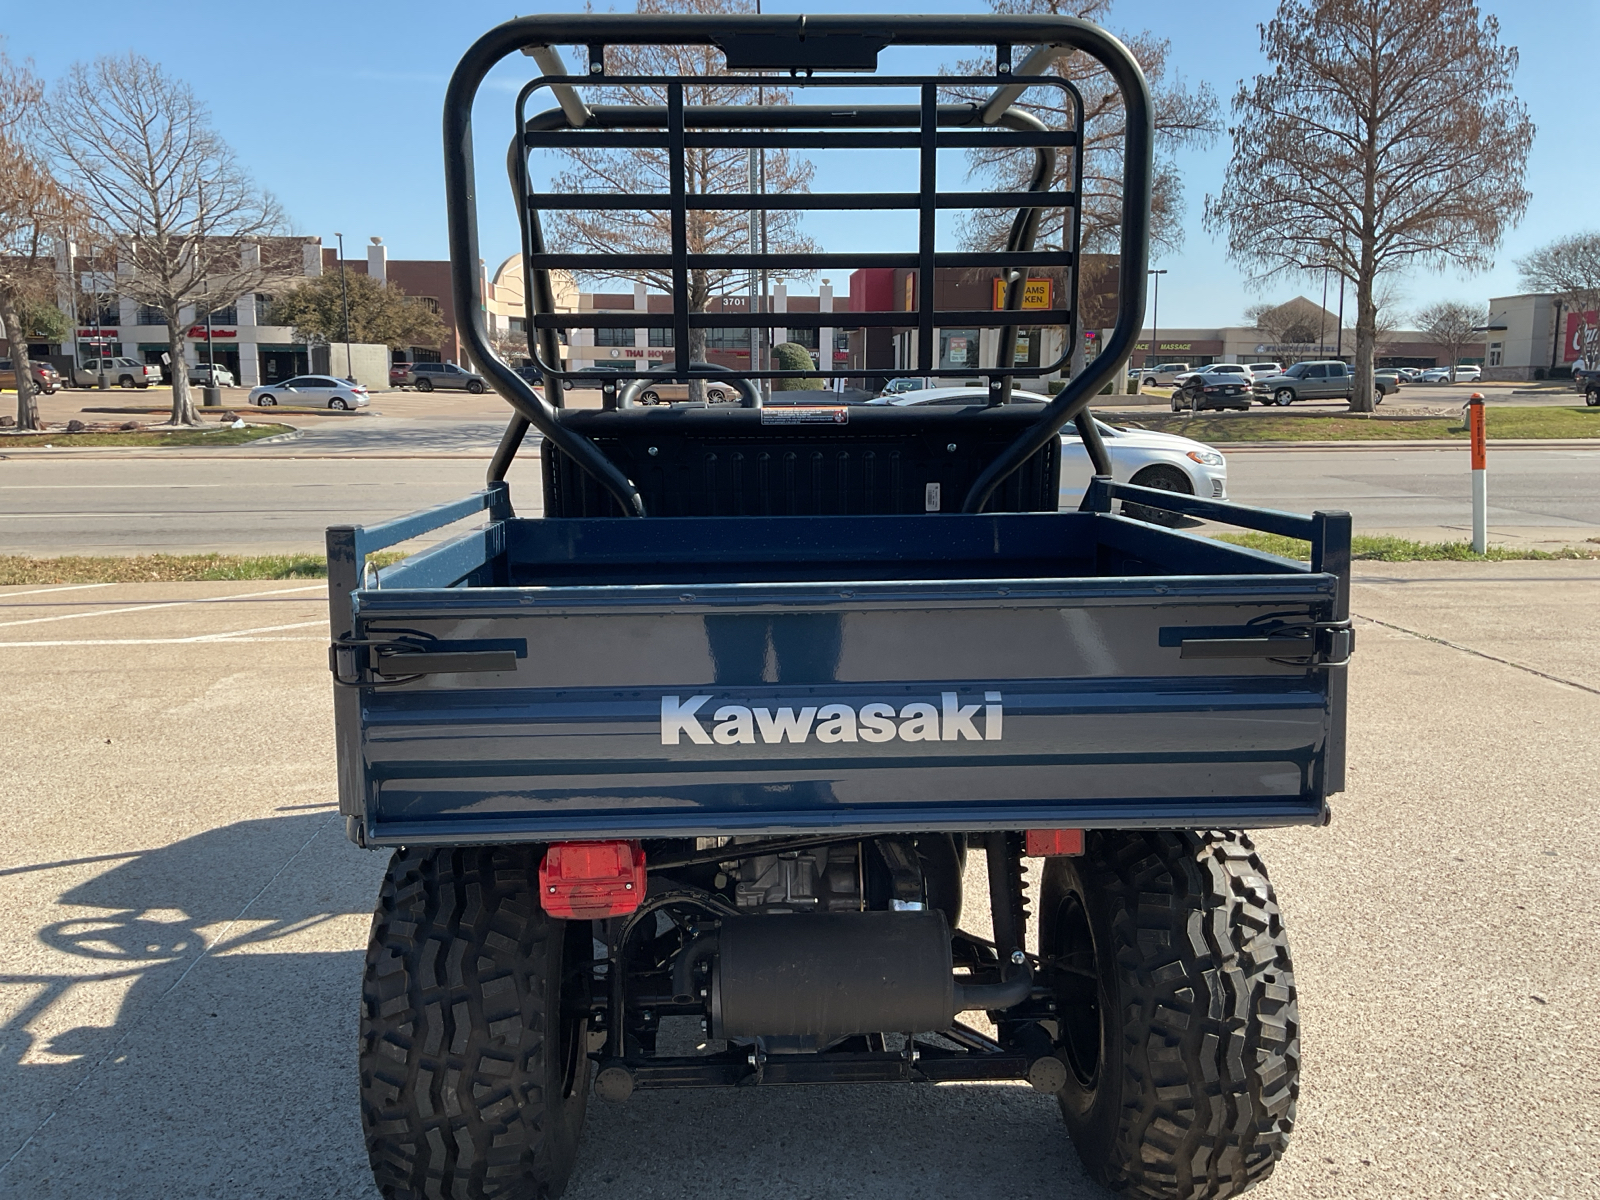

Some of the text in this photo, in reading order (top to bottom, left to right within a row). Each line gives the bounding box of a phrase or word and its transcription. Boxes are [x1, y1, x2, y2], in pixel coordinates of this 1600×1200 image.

[723, 298, 745, 306] 3701
[625, 349, 644, 358] THAI
[661, 691, 1003, 745] Kawasaki
